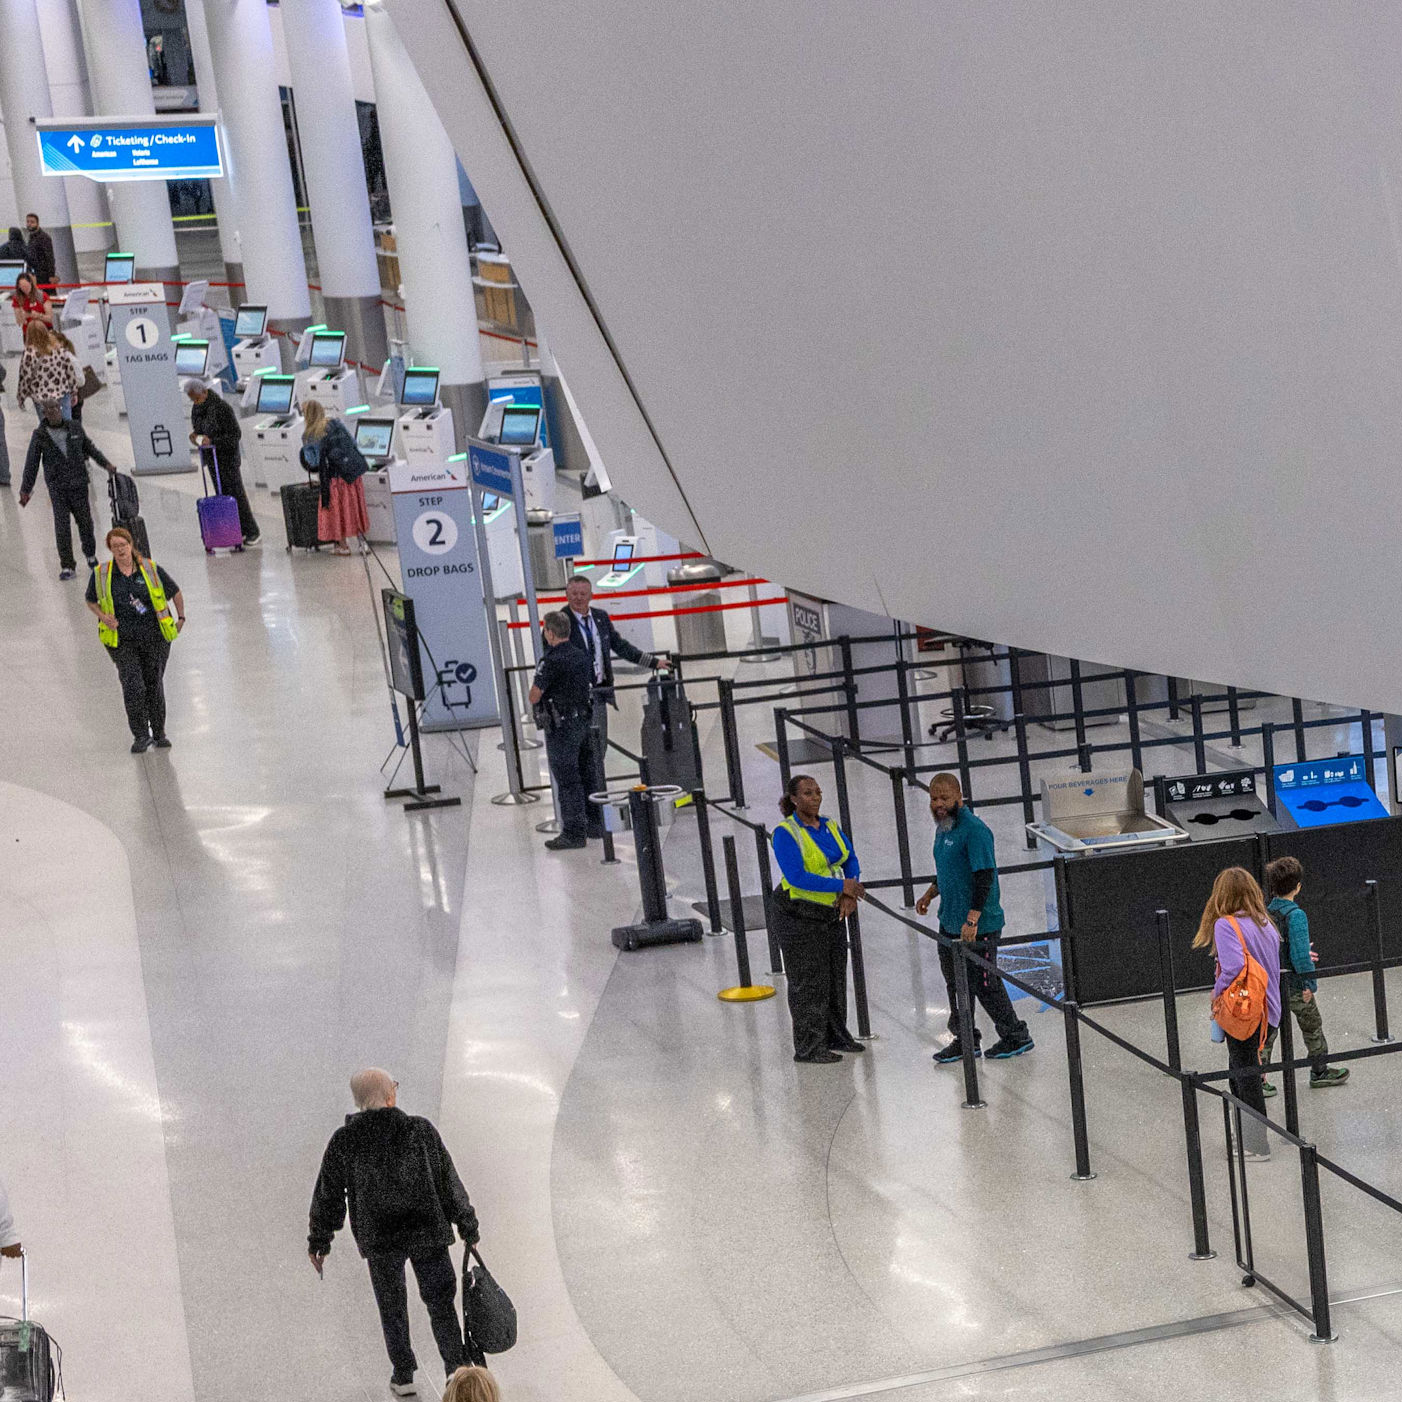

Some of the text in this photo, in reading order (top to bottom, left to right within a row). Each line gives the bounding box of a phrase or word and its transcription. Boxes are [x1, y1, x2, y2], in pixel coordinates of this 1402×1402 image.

[106, 136, 149, 147] Ticketing
[129, 307, 148, 315] STEP
[136, 324, 146, 343] 1
[125, 353, 169, 363] TAG BAGS
[410, 472, 446, 483] American
[418, 496, 443, 507] STEP
[425, 518, 446, 546] 2
[554, 534, 581, 546] ENTER
[407, 562, 474, 578] DROP BAGS
[795, 607, 819, 631] POLICE
[1068, 779, 1109, 788] BEVERAGES
